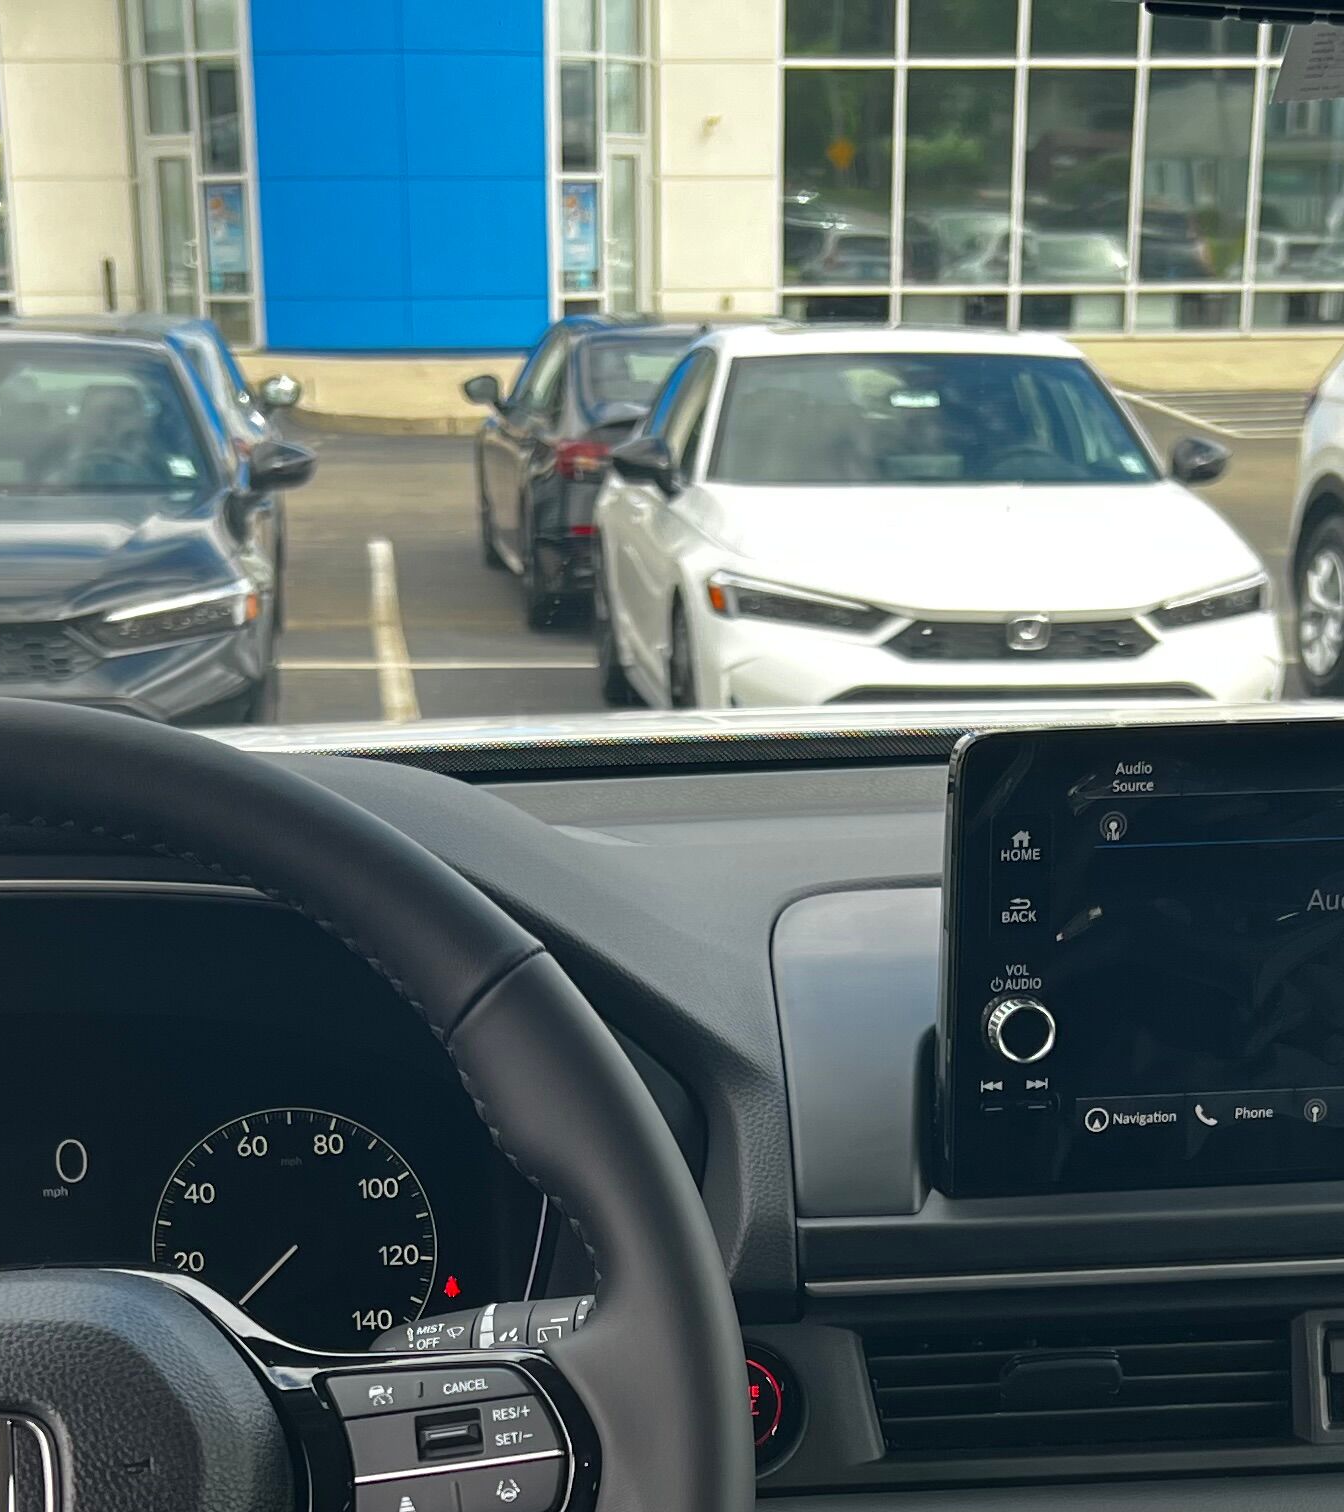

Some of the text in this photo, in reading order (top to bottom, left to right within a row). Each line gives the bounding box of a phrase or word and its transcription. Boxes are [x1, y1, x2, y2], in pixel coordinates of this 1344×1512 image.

[1115, 762, 1153, 776] Audio
[1112, 779, 1155, 793] Source
[1000, 848, 1041, 863] HOME
[1001, 909, 1037, 924] BACK
[1006, 964, 1030, 976] VOL
[1006, 977, 1042, 991] AUDIO
[1112, 1110, 1177, 1127] Navigation
[1234, 1106, 1274, 1120] Phone
[237, 1135, 268, 1157] 60
[313, 1133, 344, 1155] 80
[56, 1139, 88, 1183] 0
[43, 1186, 69, 1198] mph
[184, 1183, 215, 1204] 40
[358, 1177, 399, 1200] 100
[174, 1251, 205, 1272] 20
[378, 1244, 419, 1266] 120
[352, 1309, 392, 1331] 140
[416, 1323, 446, 1335] MIST
[416, 1337, 441, 1350] OFF
[443, 1378, 489, 1395] CANCEL
